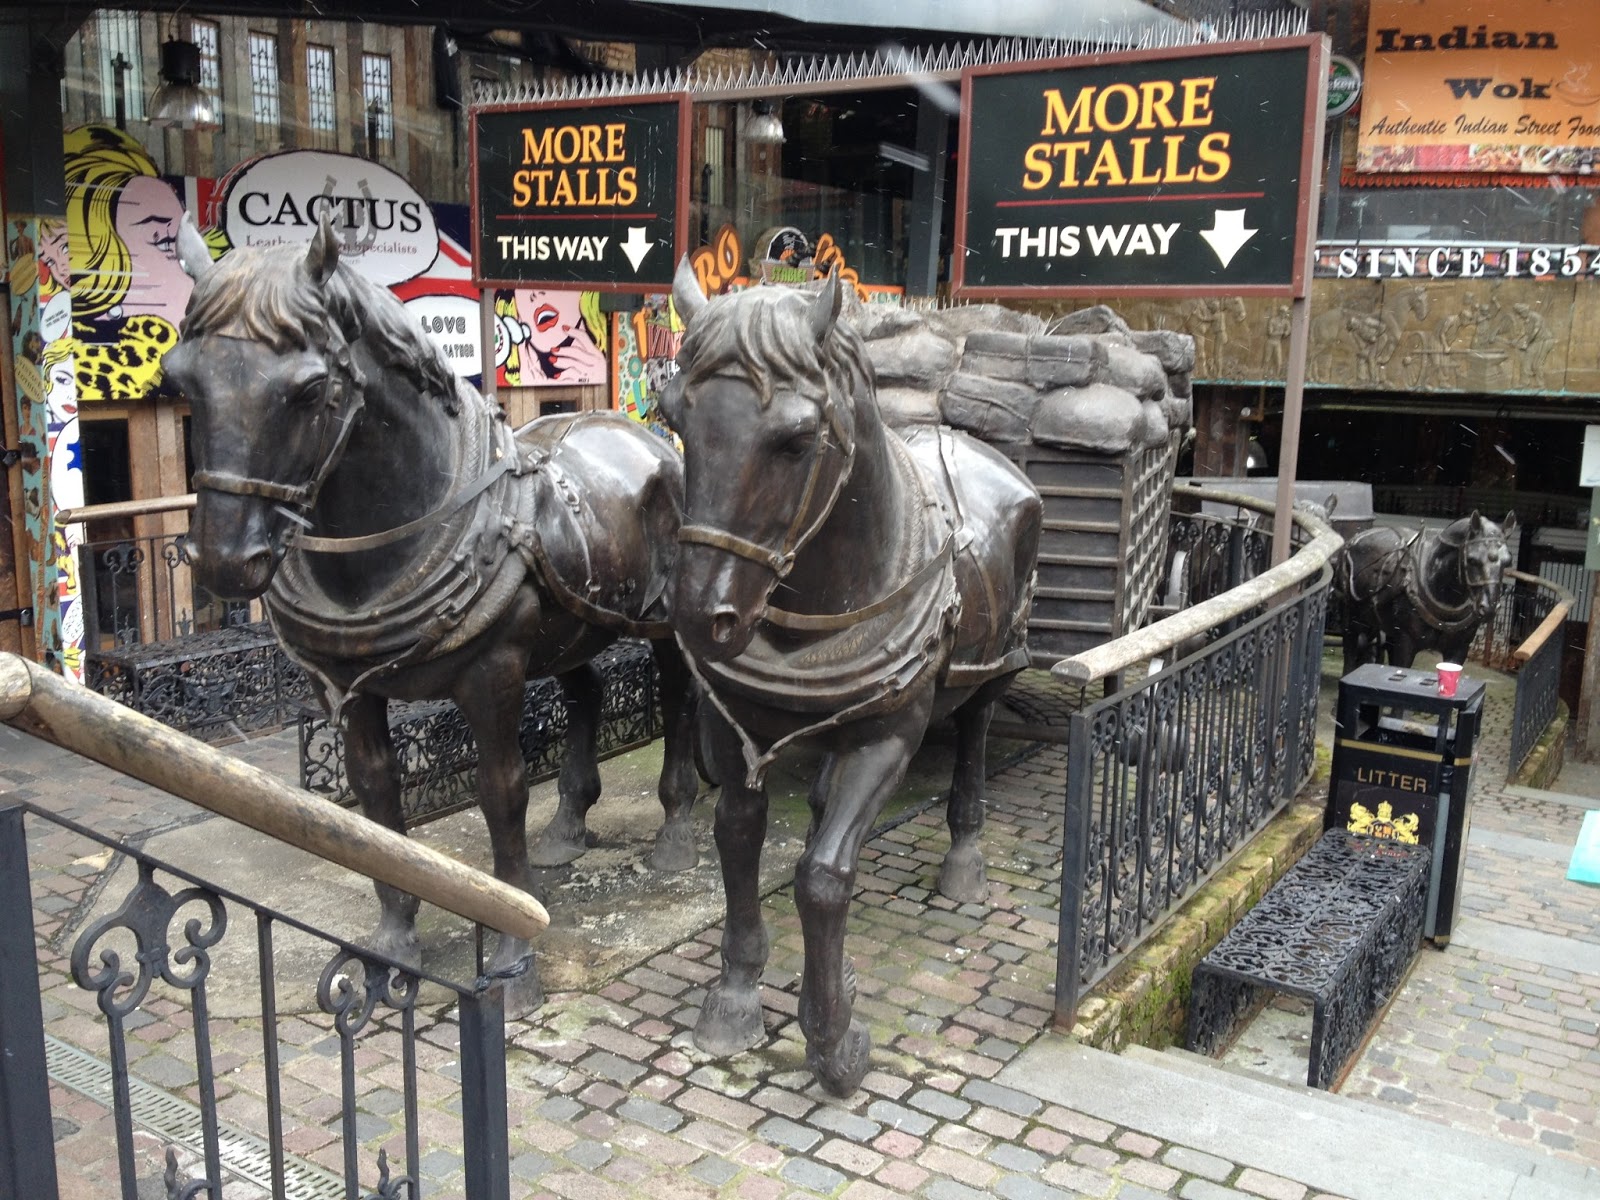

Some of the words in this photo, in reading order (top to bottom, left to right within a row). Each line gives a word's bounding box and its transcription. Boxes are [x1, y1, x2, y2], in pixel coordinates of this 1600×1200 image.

[1375, 25, 1558, 52] Indian
[1444, 78, 1552, 100] Wok
[1040, 77, 1216, 136] MORE
[1369, 115, 1448, 136] Authentic
[1454, 114, 1509, 135] Indian
[1514, 114, 1562, 137] Street
[521, 123, 627, 165] MORE
[1022, 132, 1231, 190] STALLS
[513, 166, 638, 208] STALLS
[239, 191, 422, 233] CACTUS
[497, 235, 550, 260] THIS
[553, 235, 610, 262] WAY
[995, 225, 1081, 258] THIS
[1086, 222, 1182, 257] WAY
[1337, 247, 1485, 278] SINCE
[421, 315, 466, 334] LOVE
[1358, 767, 1427, 793] LITTER
